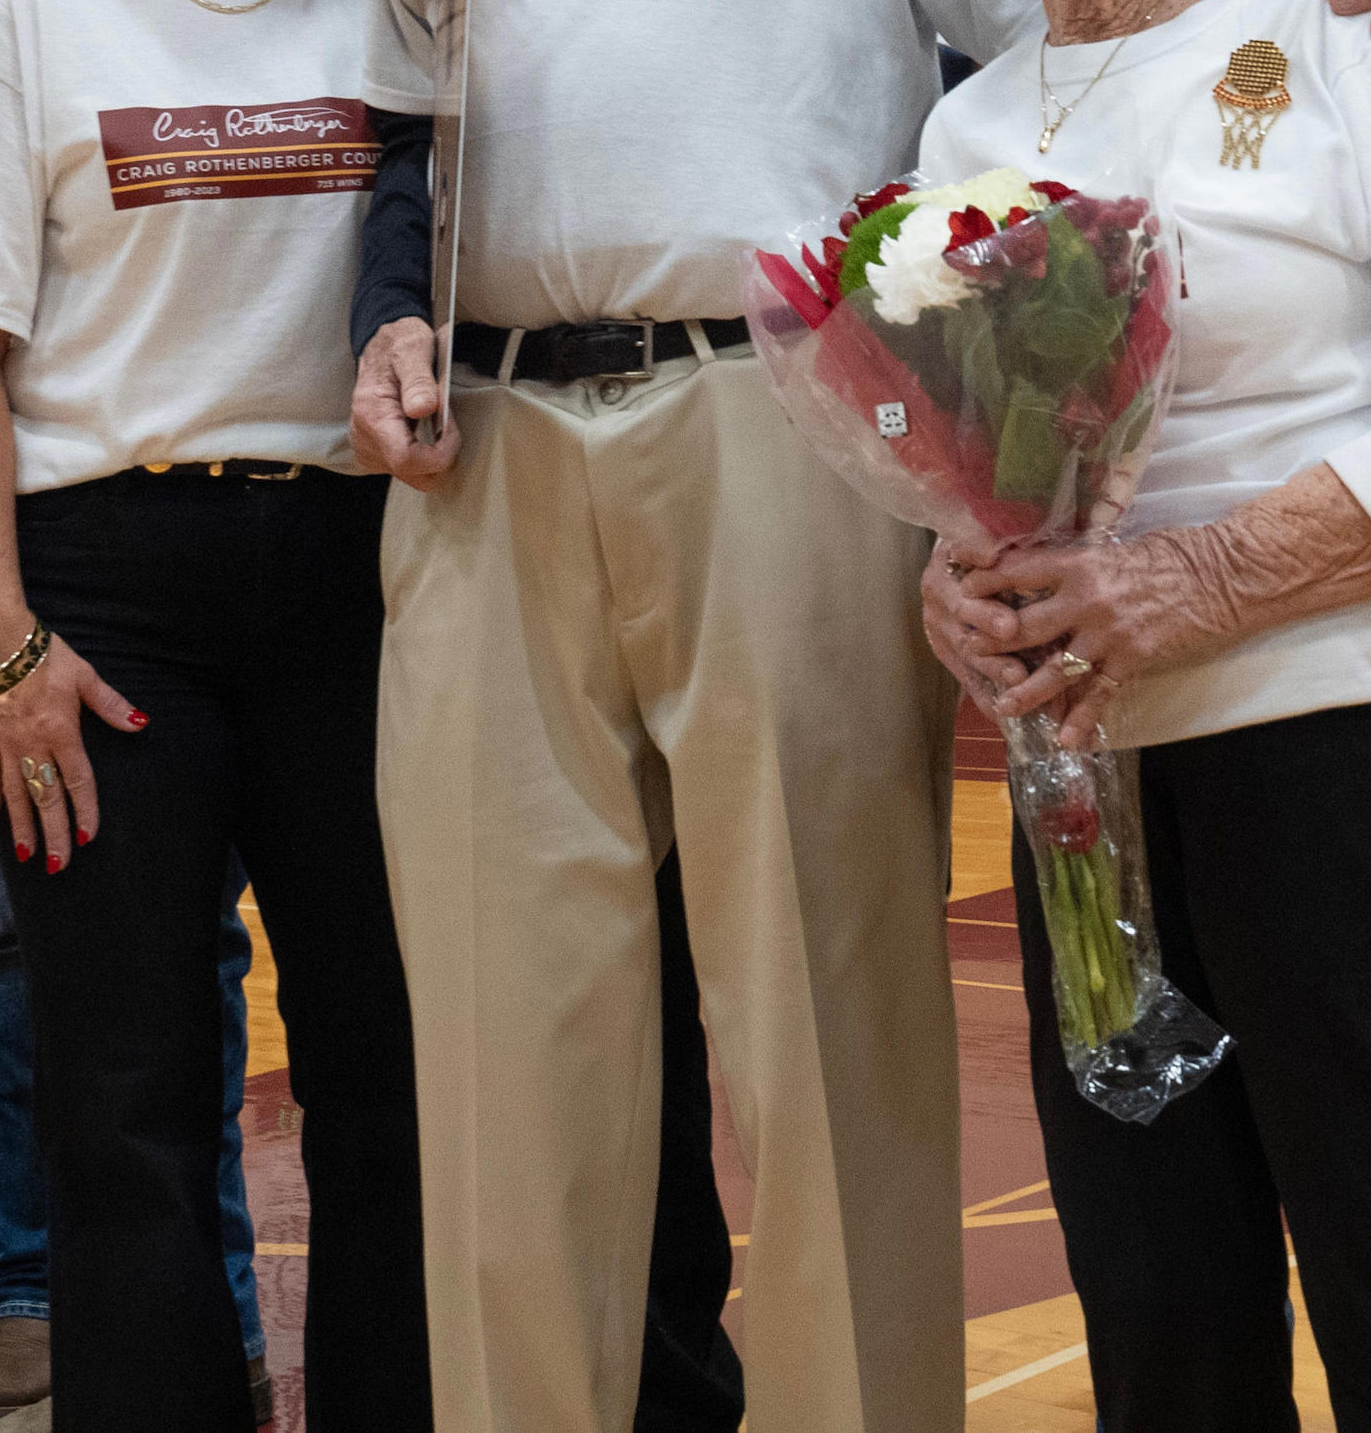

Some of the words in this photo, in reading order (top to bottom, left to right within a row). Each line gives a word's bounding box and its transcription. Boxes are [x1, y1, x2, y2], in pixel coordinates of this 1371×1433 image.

[153, 112, 219, 147] Craig
[117, 161, 177, 182] CRAIG
[185, 153, 334, 174] ROTHENBERGER
[342, 152, 382, 166] COU
[336, 178, 363, 188] WINS
